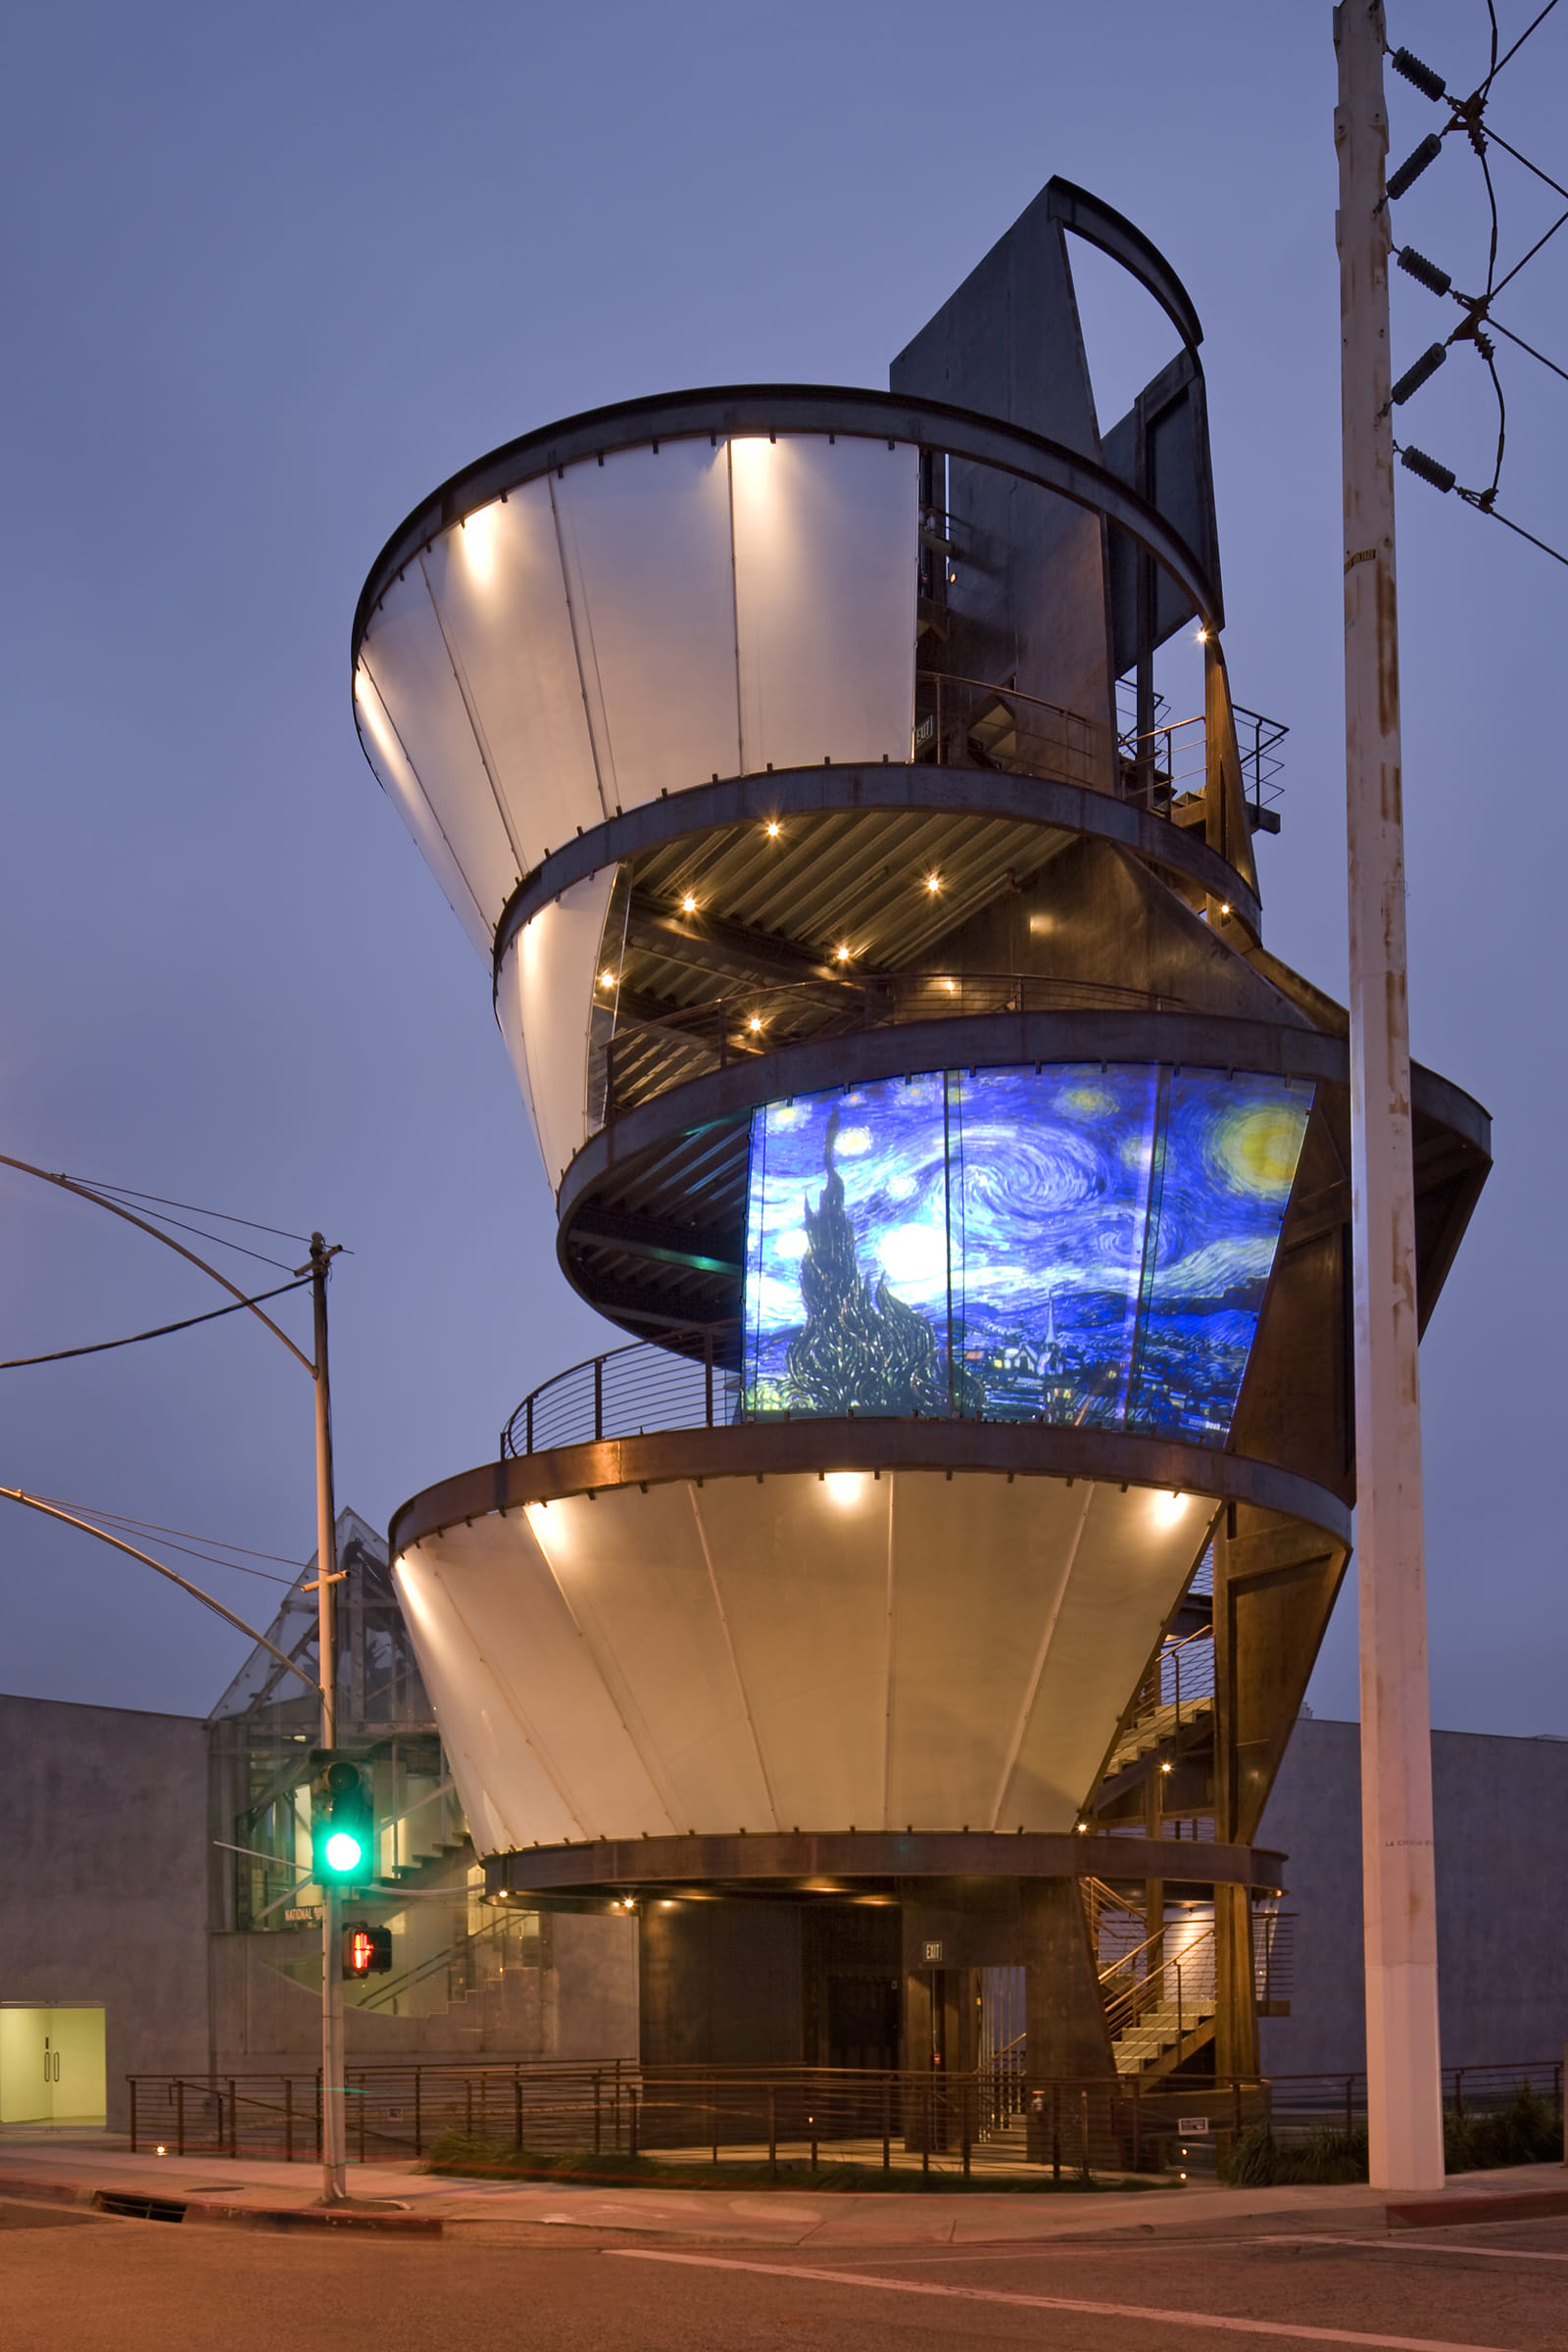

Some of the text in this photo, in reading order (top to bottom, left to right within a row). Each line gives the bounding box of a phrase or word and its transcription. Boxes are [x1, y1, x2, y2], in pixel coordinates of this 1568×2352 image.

[916, 720, 930, 742] EXIT
[285, 1907, 313, 1921] NATIONAL
[926, 1944, 940, 1959] EXIT
